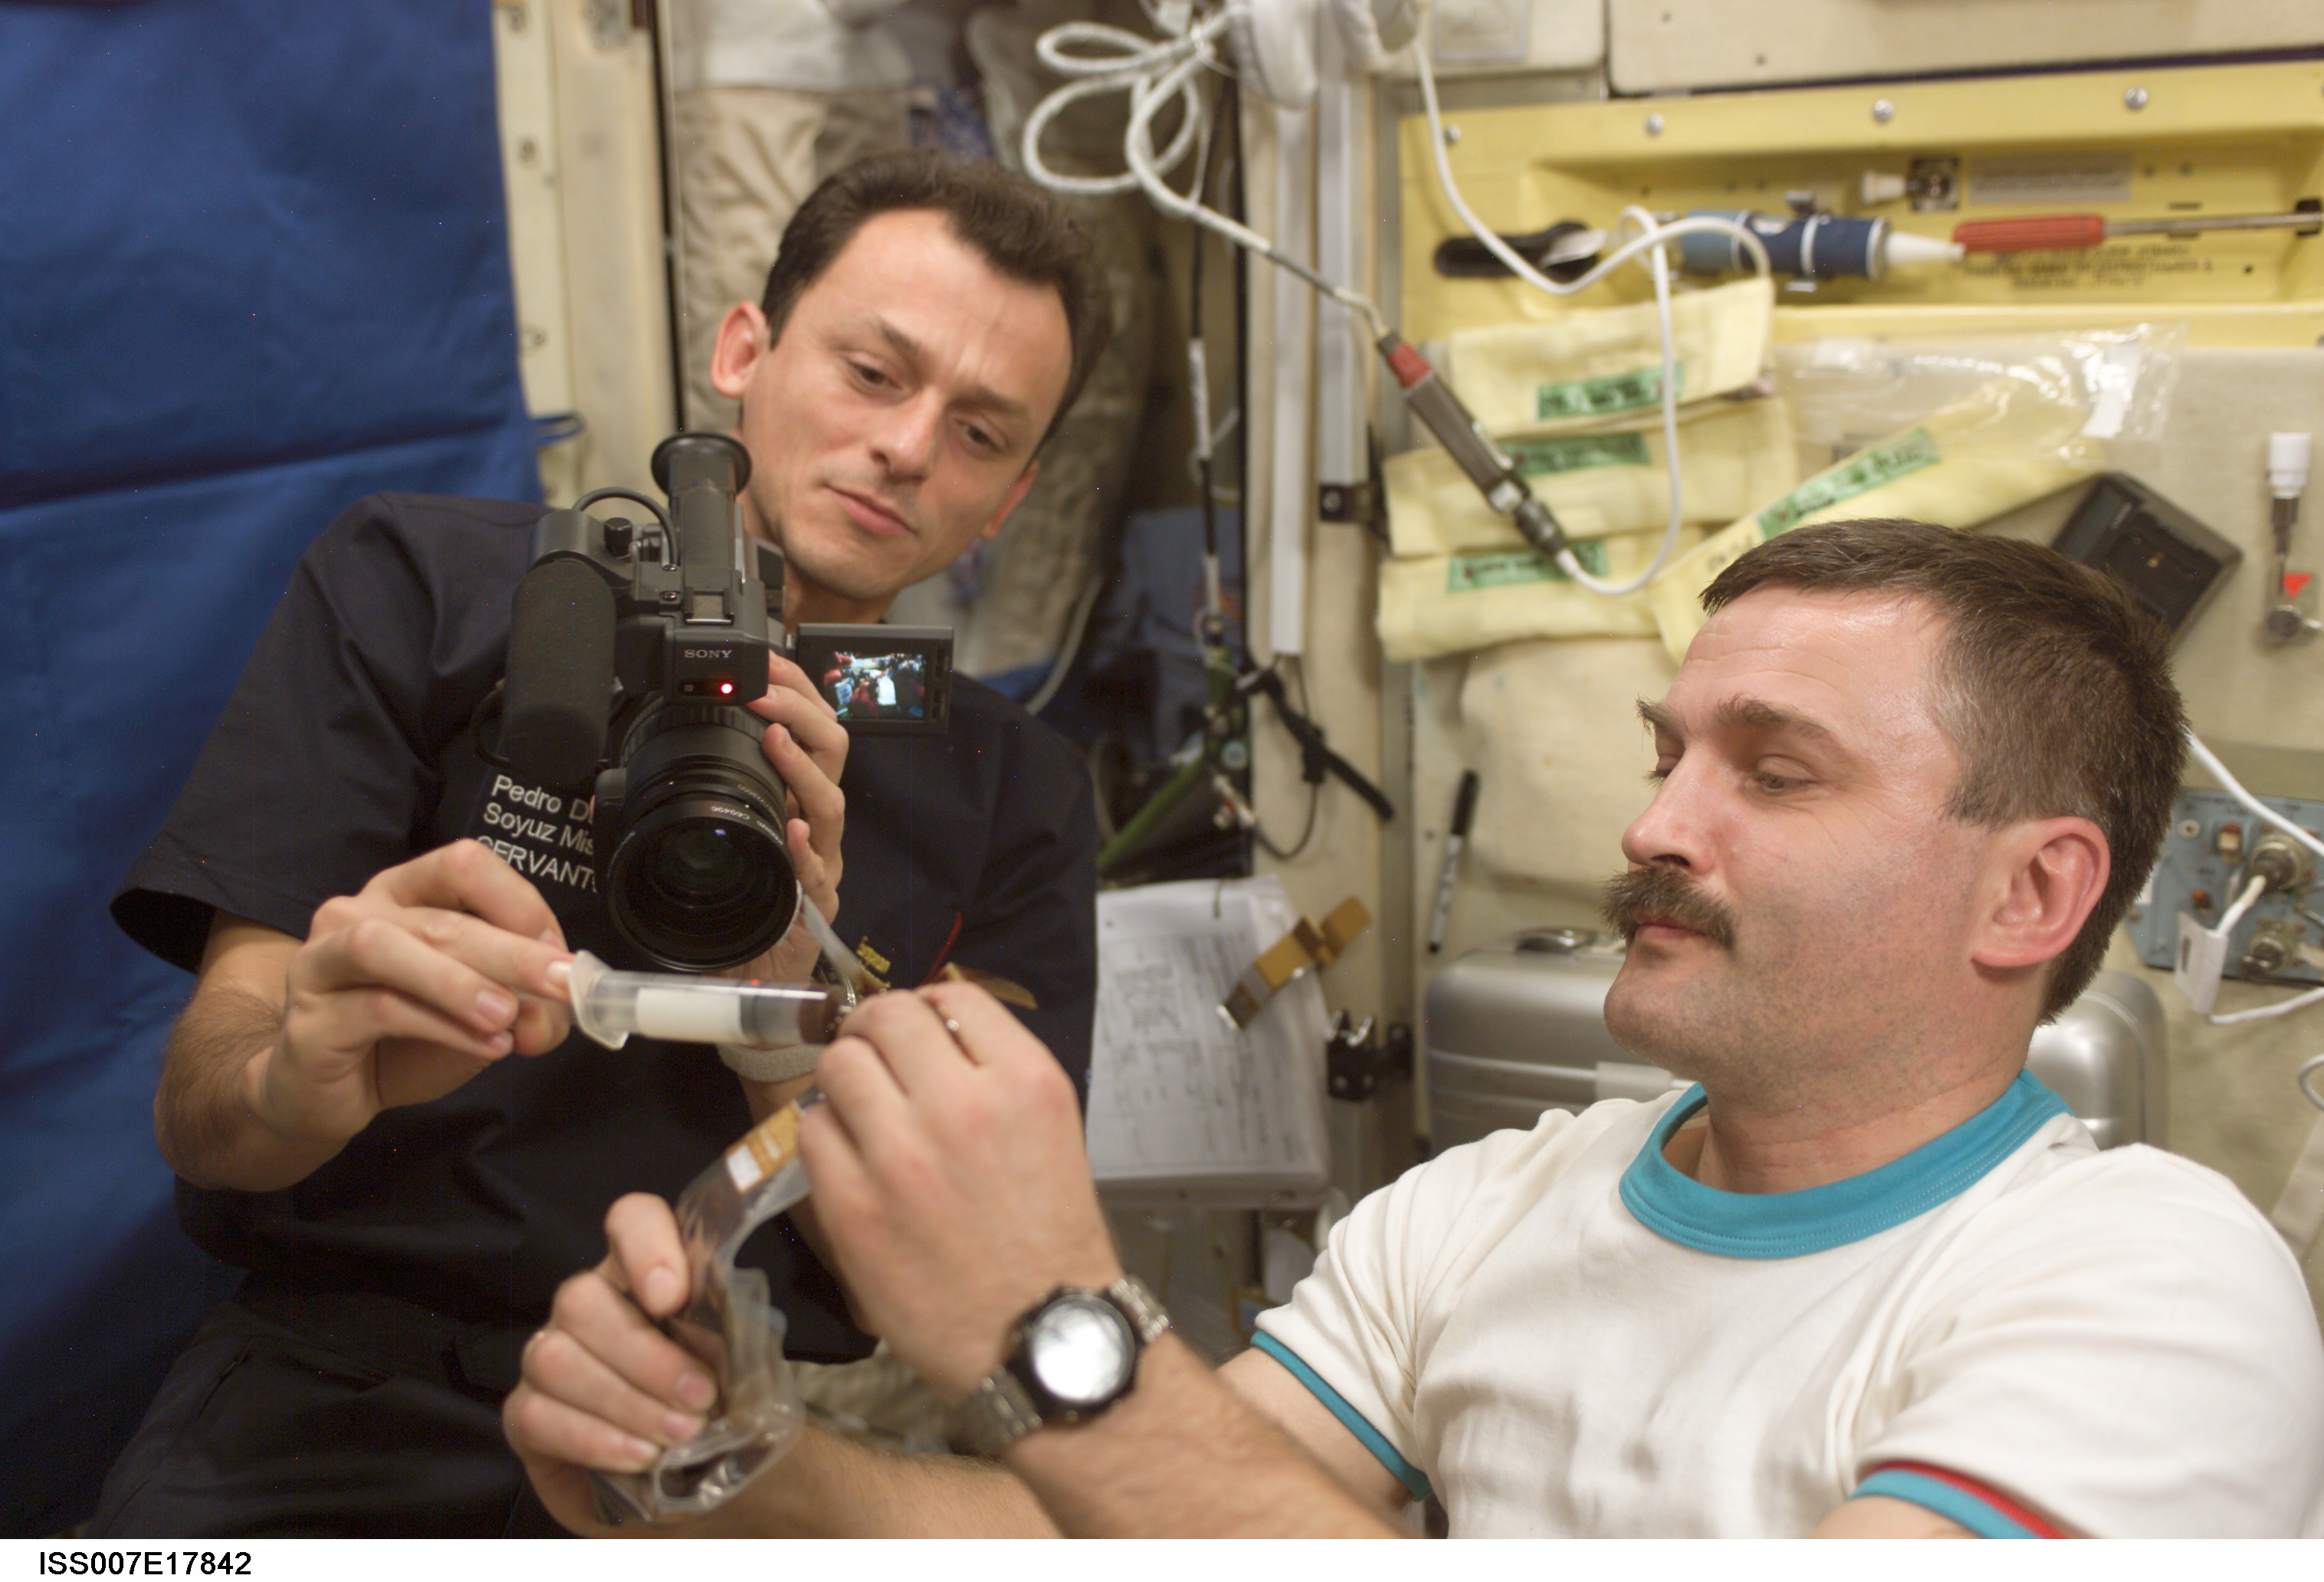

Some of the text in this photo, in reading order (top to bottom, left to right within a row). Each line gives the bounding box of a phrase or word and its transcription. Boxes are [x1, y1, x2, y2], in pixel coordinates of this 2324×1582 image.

[684, 649, 732, 658] SONY
[491, 775, 593, 824] Pedro D
[484, 802, 557, 843] Soyuz
